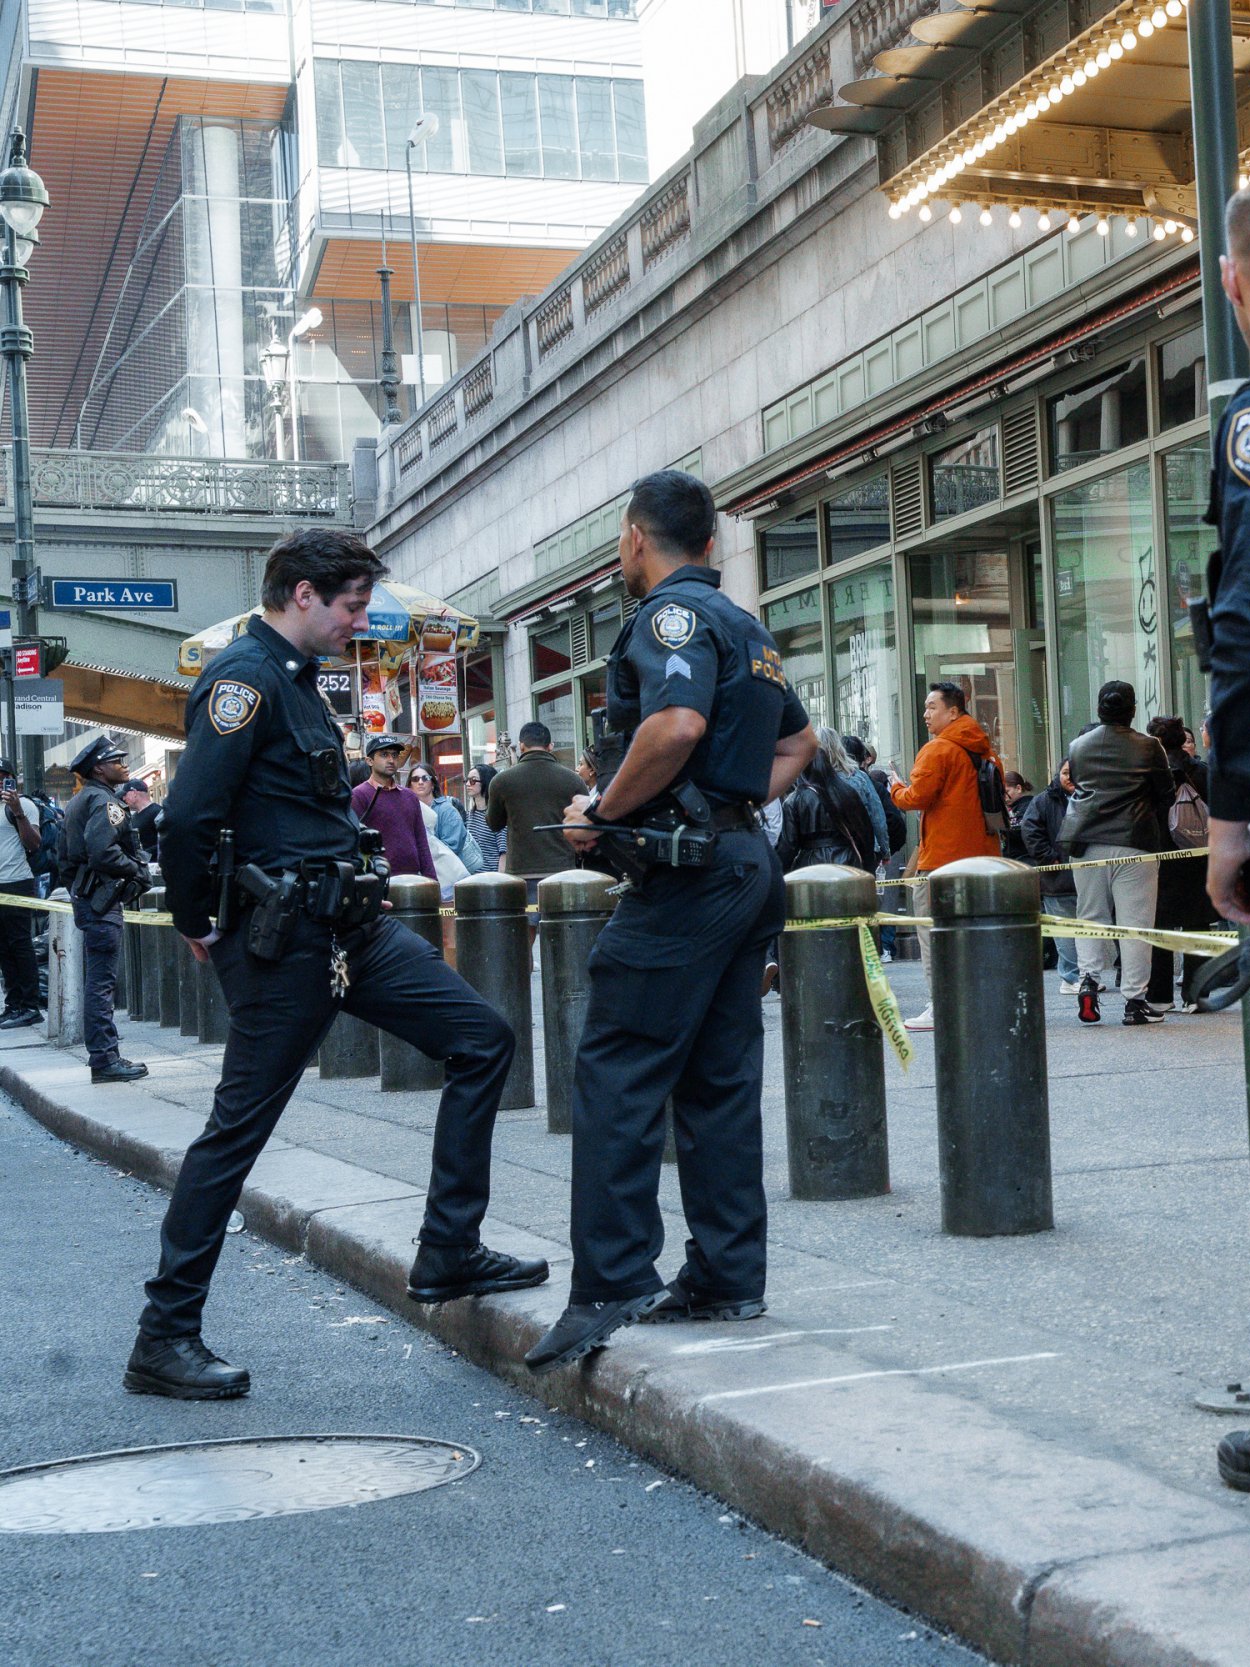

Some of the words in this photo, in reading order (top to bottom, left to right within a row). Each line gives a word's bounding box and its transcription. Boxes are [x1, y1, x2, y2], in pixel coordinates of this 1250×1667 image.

[73, 586, 115, 603] Park
[119, 587, 154, 603] Ave
[657, 607, 690, 624] POLICE
[762, 645, 782, 667] MTA
[317, 675, 350, 692] 252
[14, 694, 30, 702] rand
[217, 684, 256, 705] POLICE
[15, 702, 42, 710] adison
